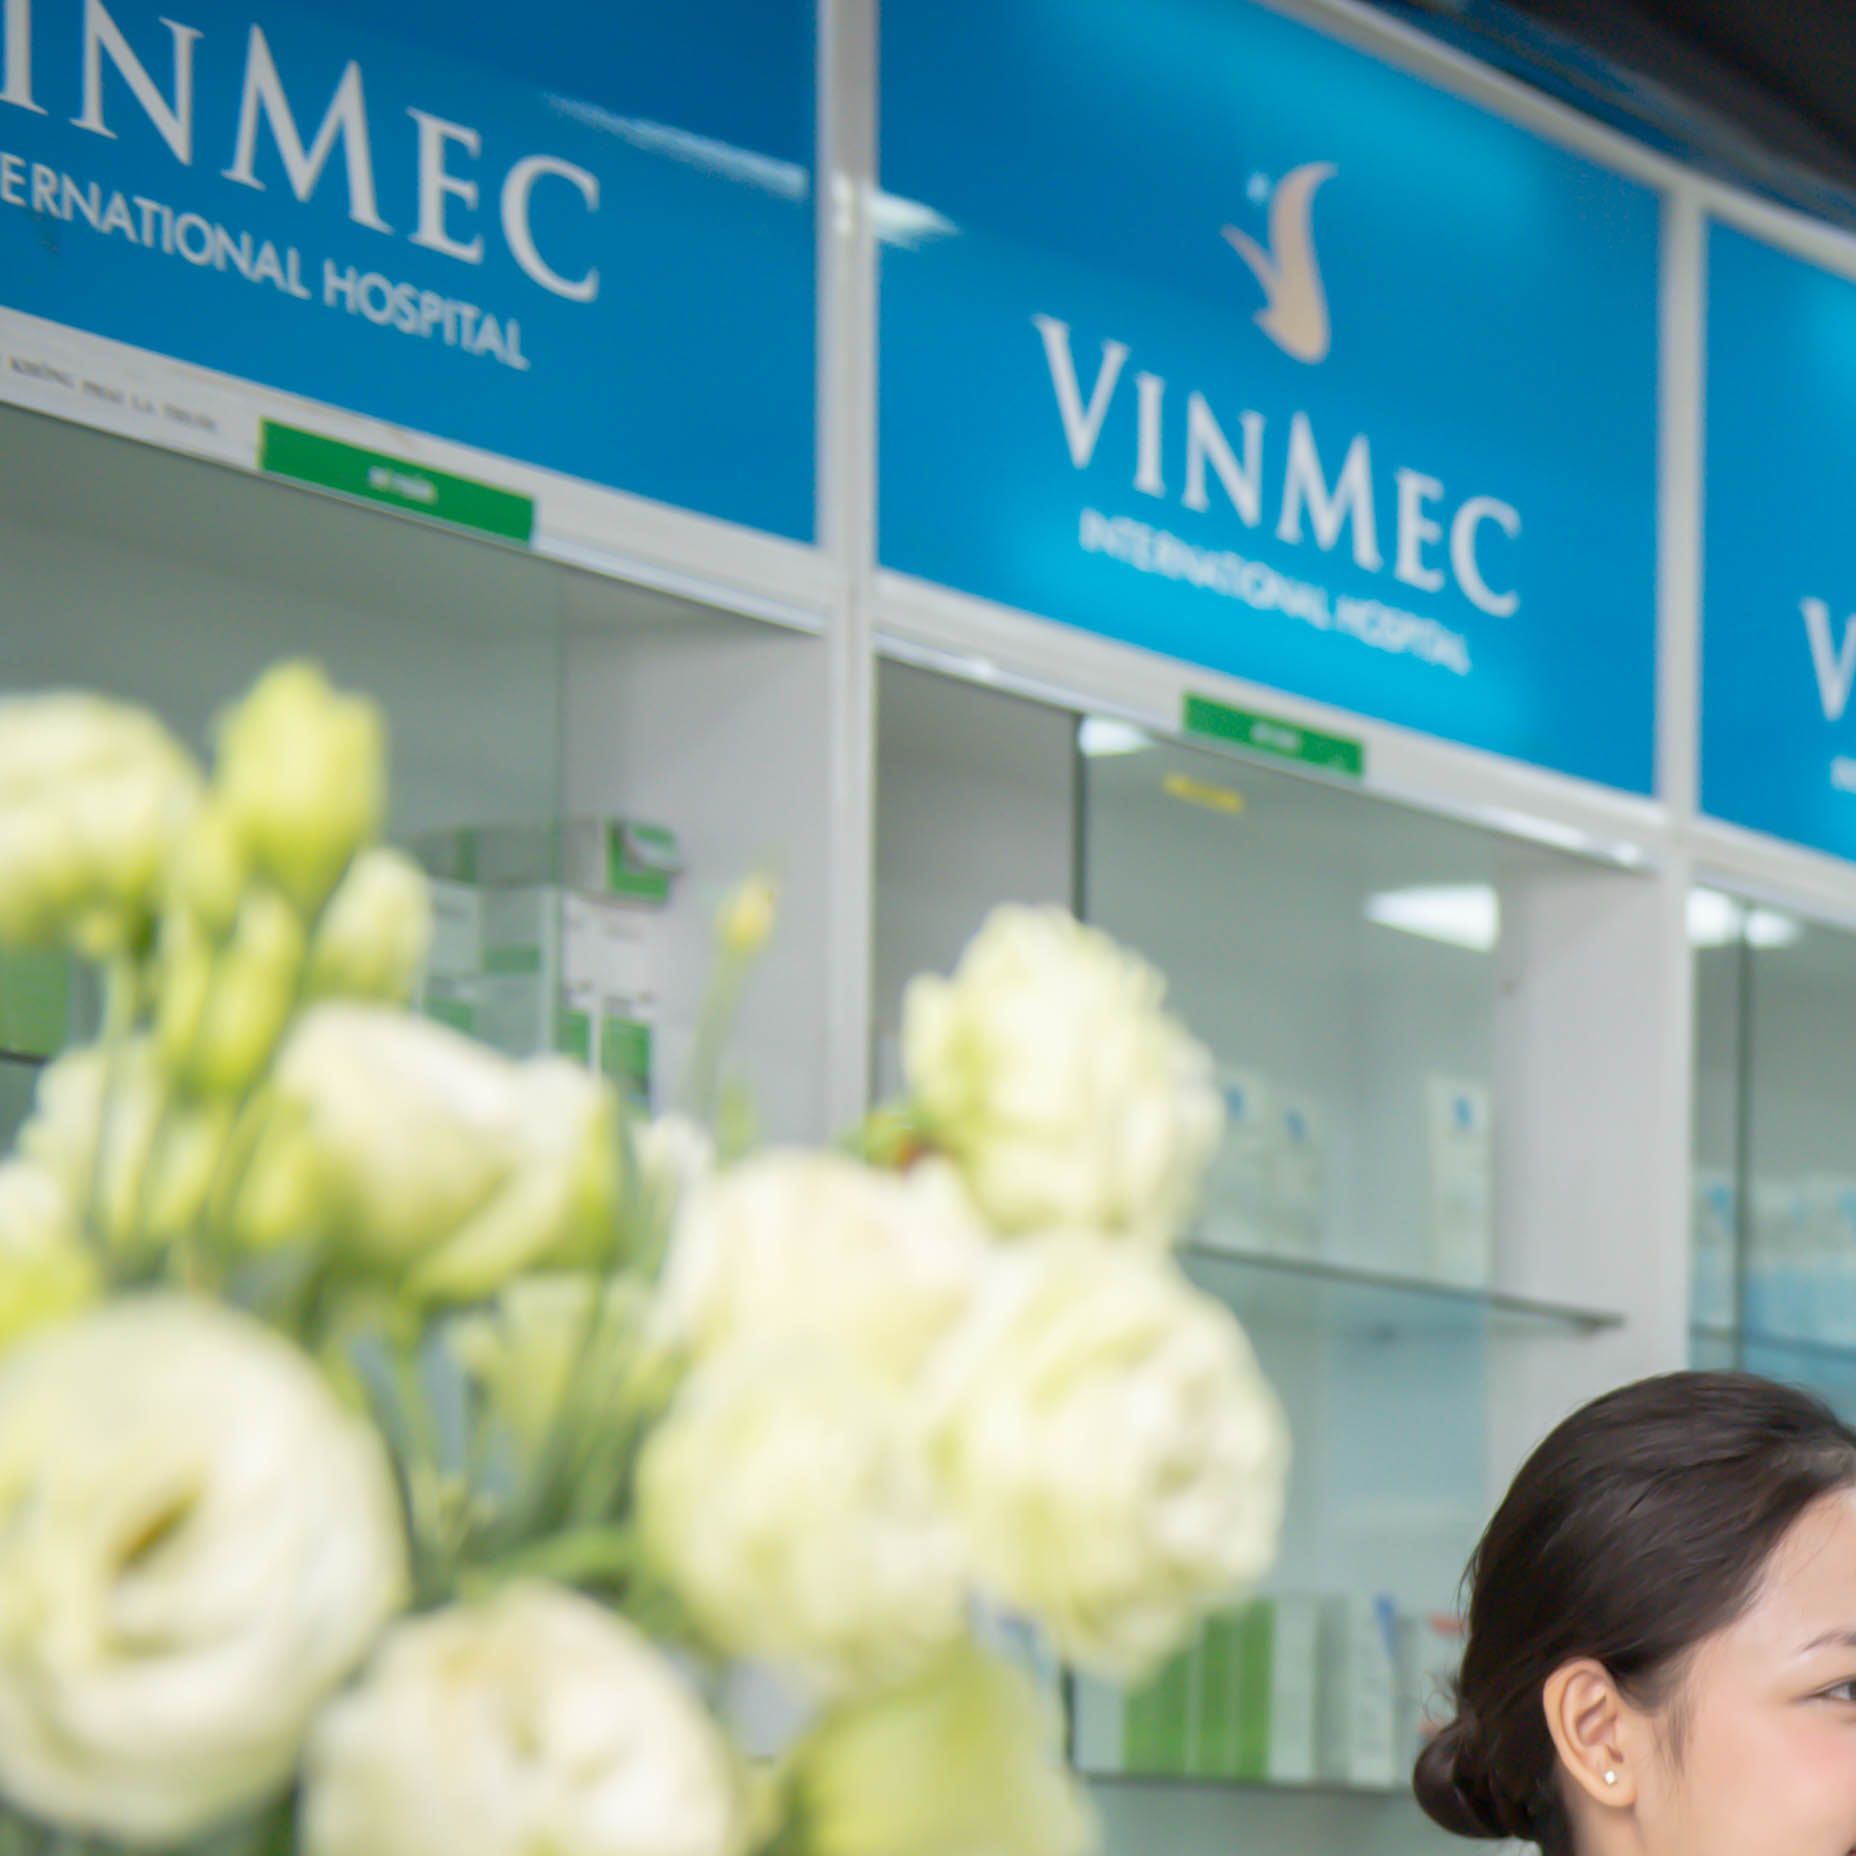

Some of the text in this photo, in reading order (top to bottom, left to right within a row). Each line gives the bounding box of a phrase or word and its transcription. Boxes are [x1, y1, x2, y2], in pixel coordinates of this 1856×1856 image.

[0, 0, 601, 303] INMEC
[0, 153, 531, 372] ERNATIONAL HOSPITAL
[1034, 315, 1521, 618] VINMEC
